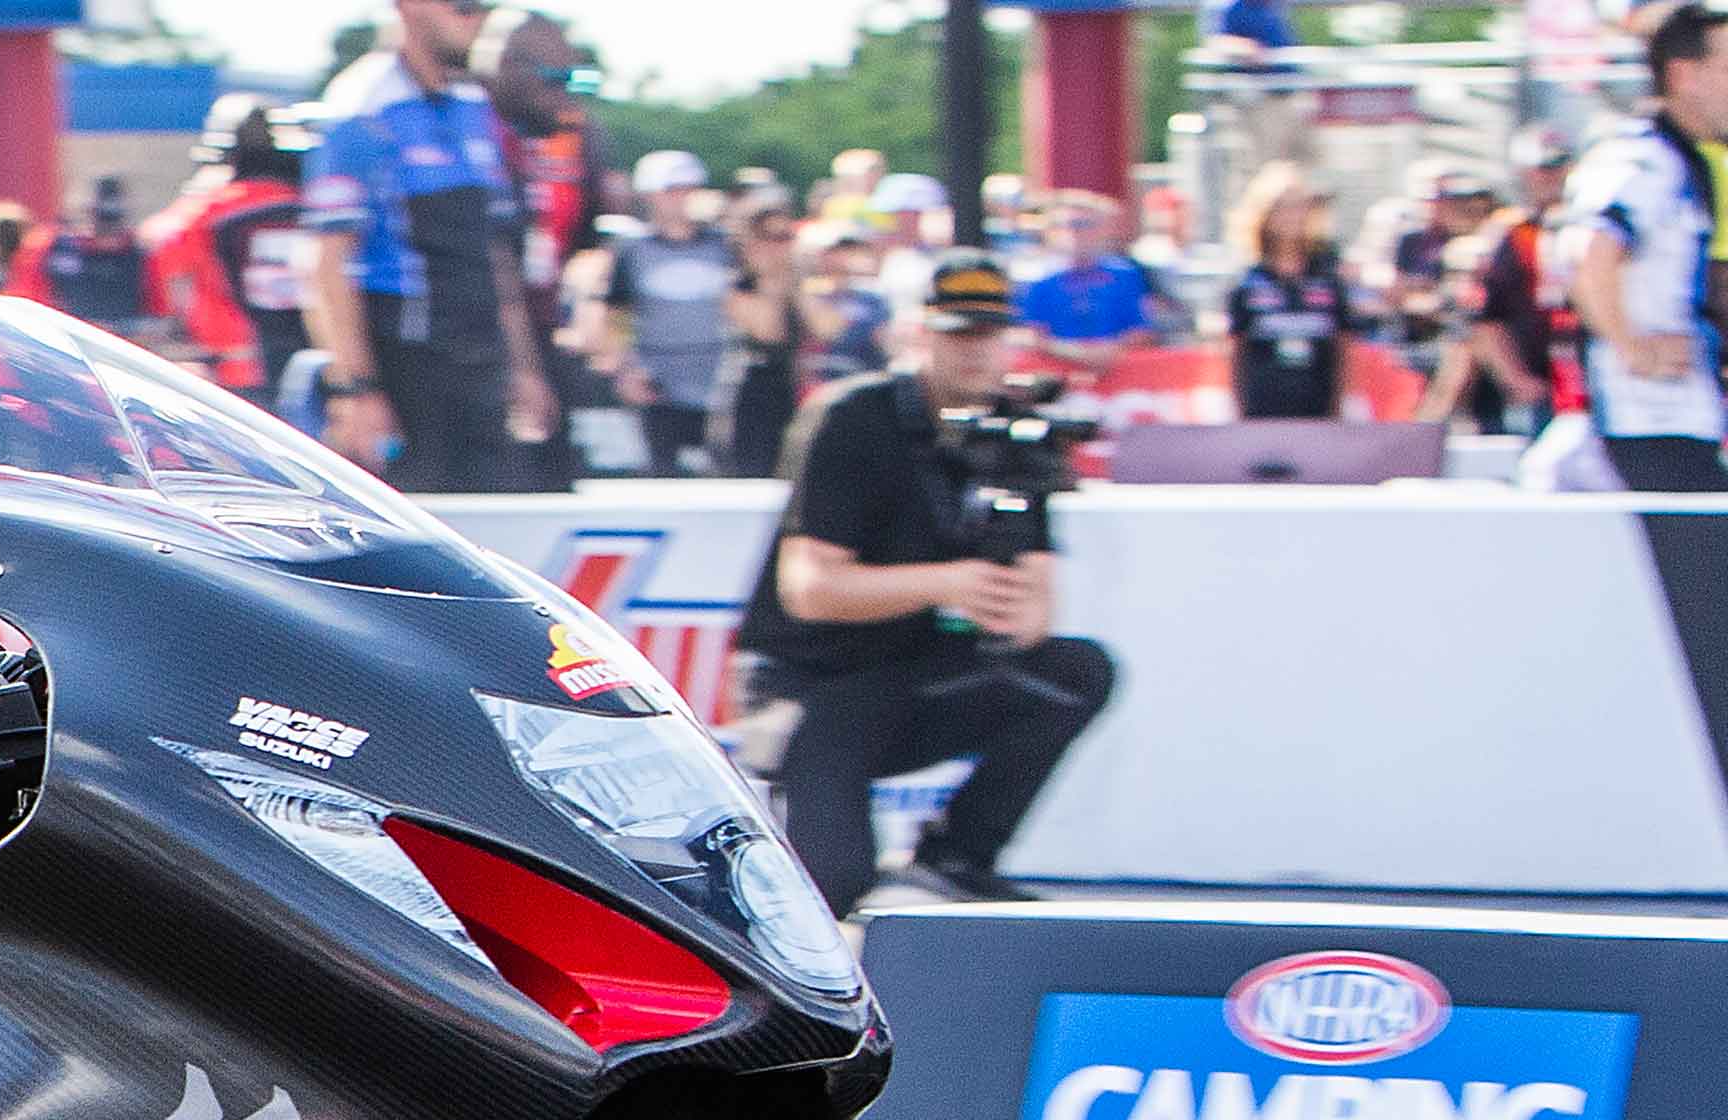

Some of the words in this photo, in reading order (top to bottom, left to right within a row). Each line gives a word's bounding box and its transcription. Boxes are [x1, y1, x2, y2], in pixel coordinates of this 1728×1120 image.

[228, 711, 358, 758] HINES
[237, 696, 370, 746] VANCE
[238, 731, 333, 770] SUZUKI
